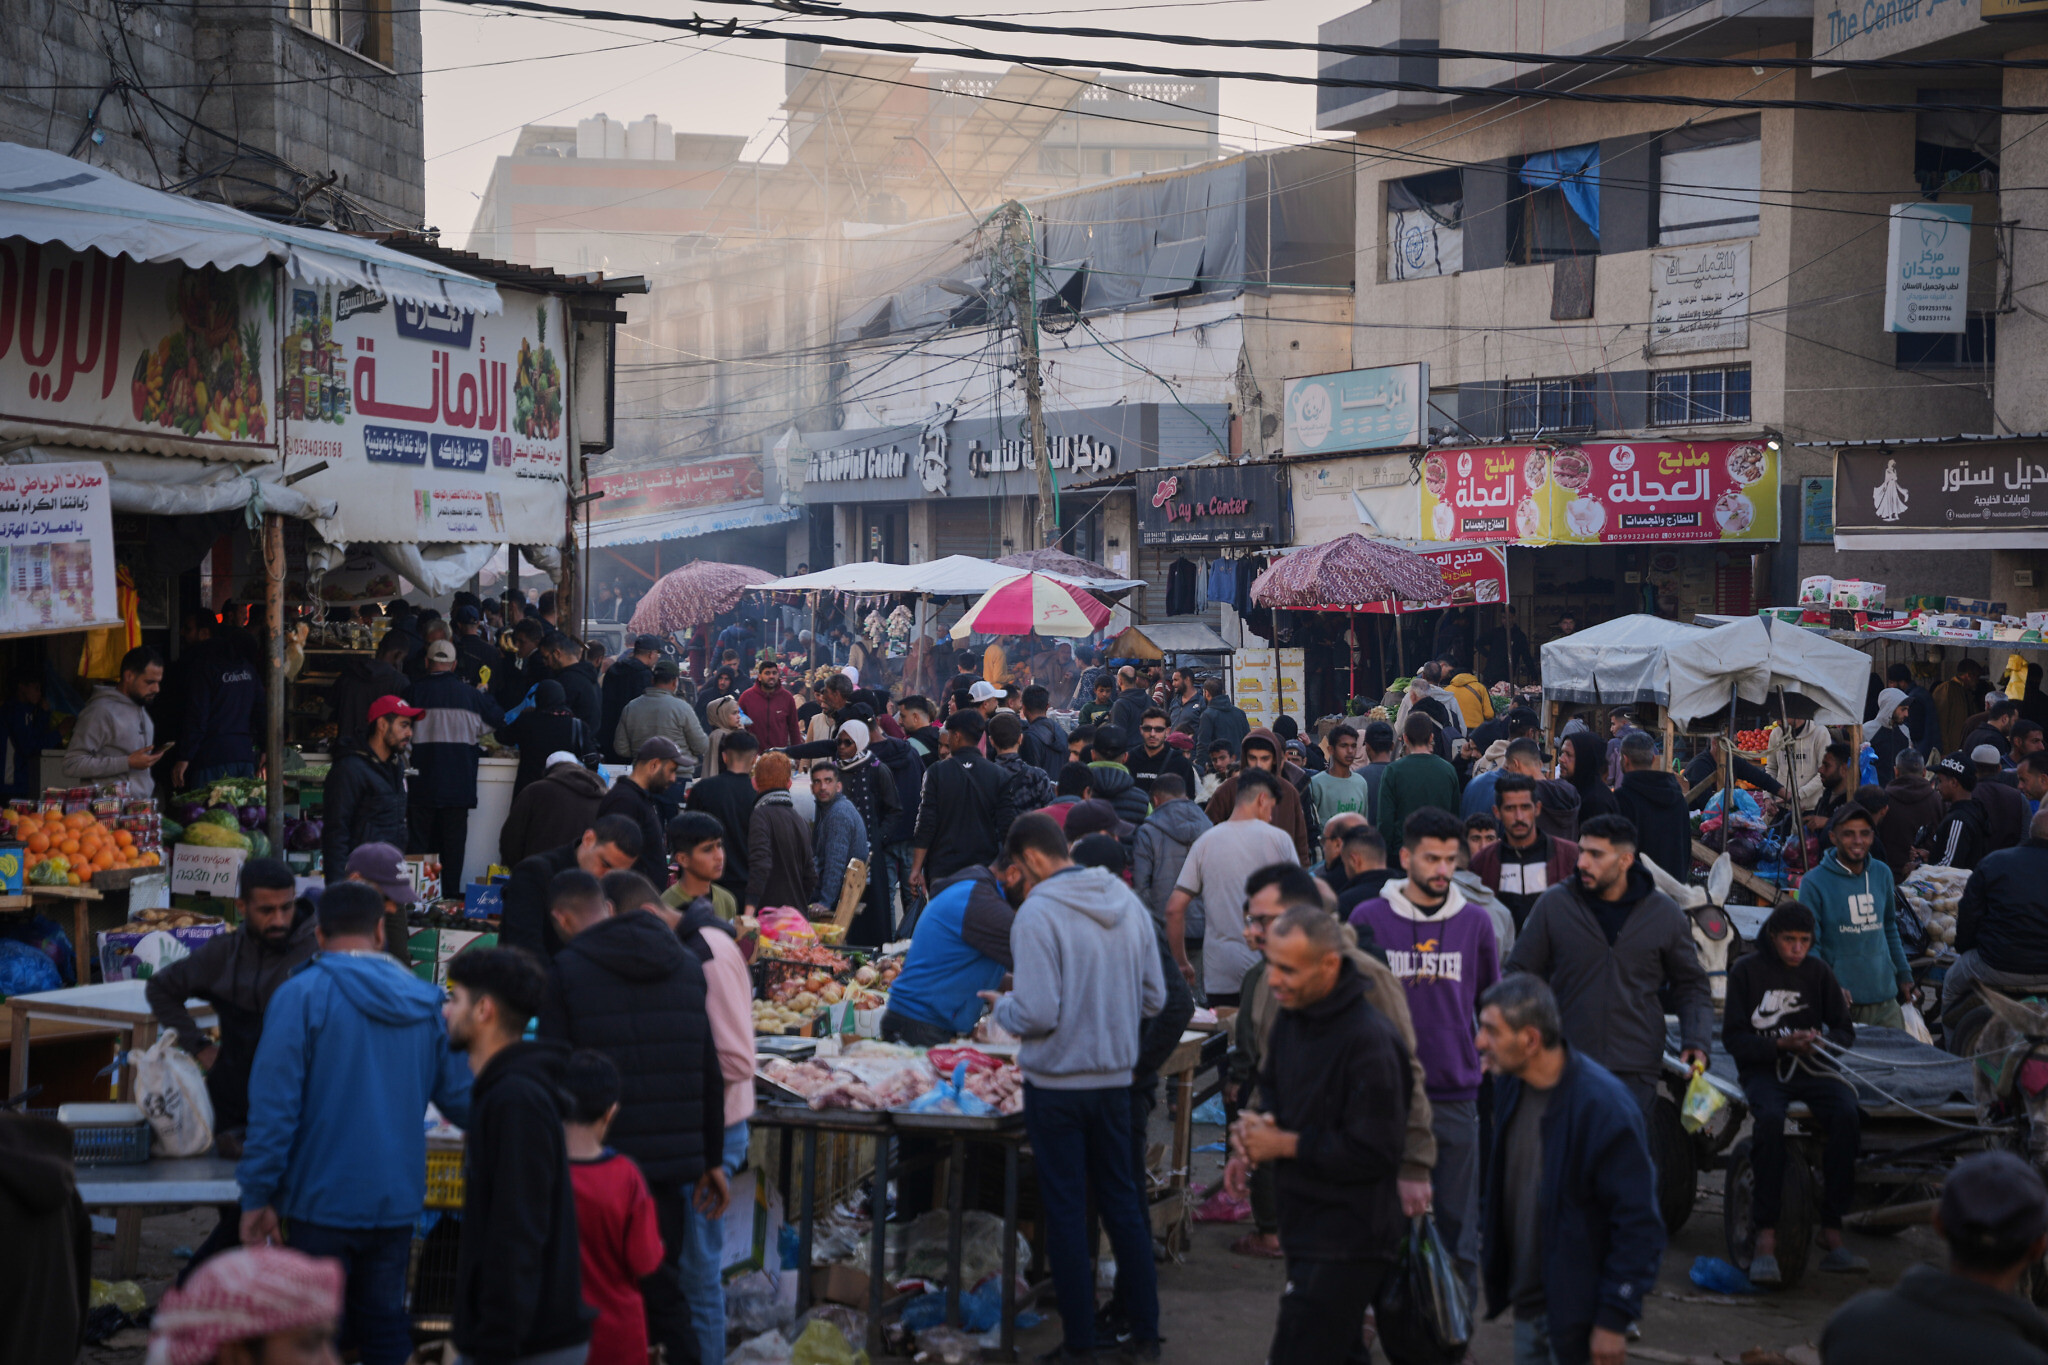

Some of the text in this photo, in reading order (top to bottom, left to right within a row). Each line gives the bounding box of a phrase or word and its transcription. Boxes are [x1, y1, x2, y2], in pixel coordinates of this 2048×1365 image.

[1828, 9, 1858, 45] The
[1863, 0, 1919, 35] Center
[1919, 249, 1944, 264] مركز
[1902, 260, 1960, 280] سويدان
[1922, 282, 1945, 292] وتجميل
[1945, 282, 1960, 291] لطب
[0, 243, 127, 403] الريا
[353, 336, 507, 432] الأمانة
[294, 439, 342, 458] 0594036168
[462, 441, 483, 466] خضار
[1071, 434, 1112, 474] مركز
[1484, 450, 1515, 481] مذبح
[1657, 443, 1710, 475] مذبح
[65, 473, 102, 488] محلات
[1941, 457, 2048, 492] ديل ستور
[1455, 474, 1515, 517] العجلة
[1608, 468, 1710, 512] العجلة
[22, 498, 57, 516] الكرام
[59, 495, 89, 512] زبائننا
[1209, 495, 1248, 516] Center
[1974, 494, 2030, 507] للعبايات الخليجية
[30, 519, 83, 536] بالعملات
[1487, 519, 1505, 532] للطازج
[1625, 514, 1694, 527] للطازج والمجمدات
[1214, 532, 1229, 542] ملابس
[1251, 530, 1264, 539] أحذية
[1453, 550, 1482, 569] مذبح
[1235, 655, 1271, 671] ليان
[1941, 758, 1966, 775] adida
[1385, 948, 1463, 983] HOLLISTER
[1759, 989, 1801, 1013] NIKE
